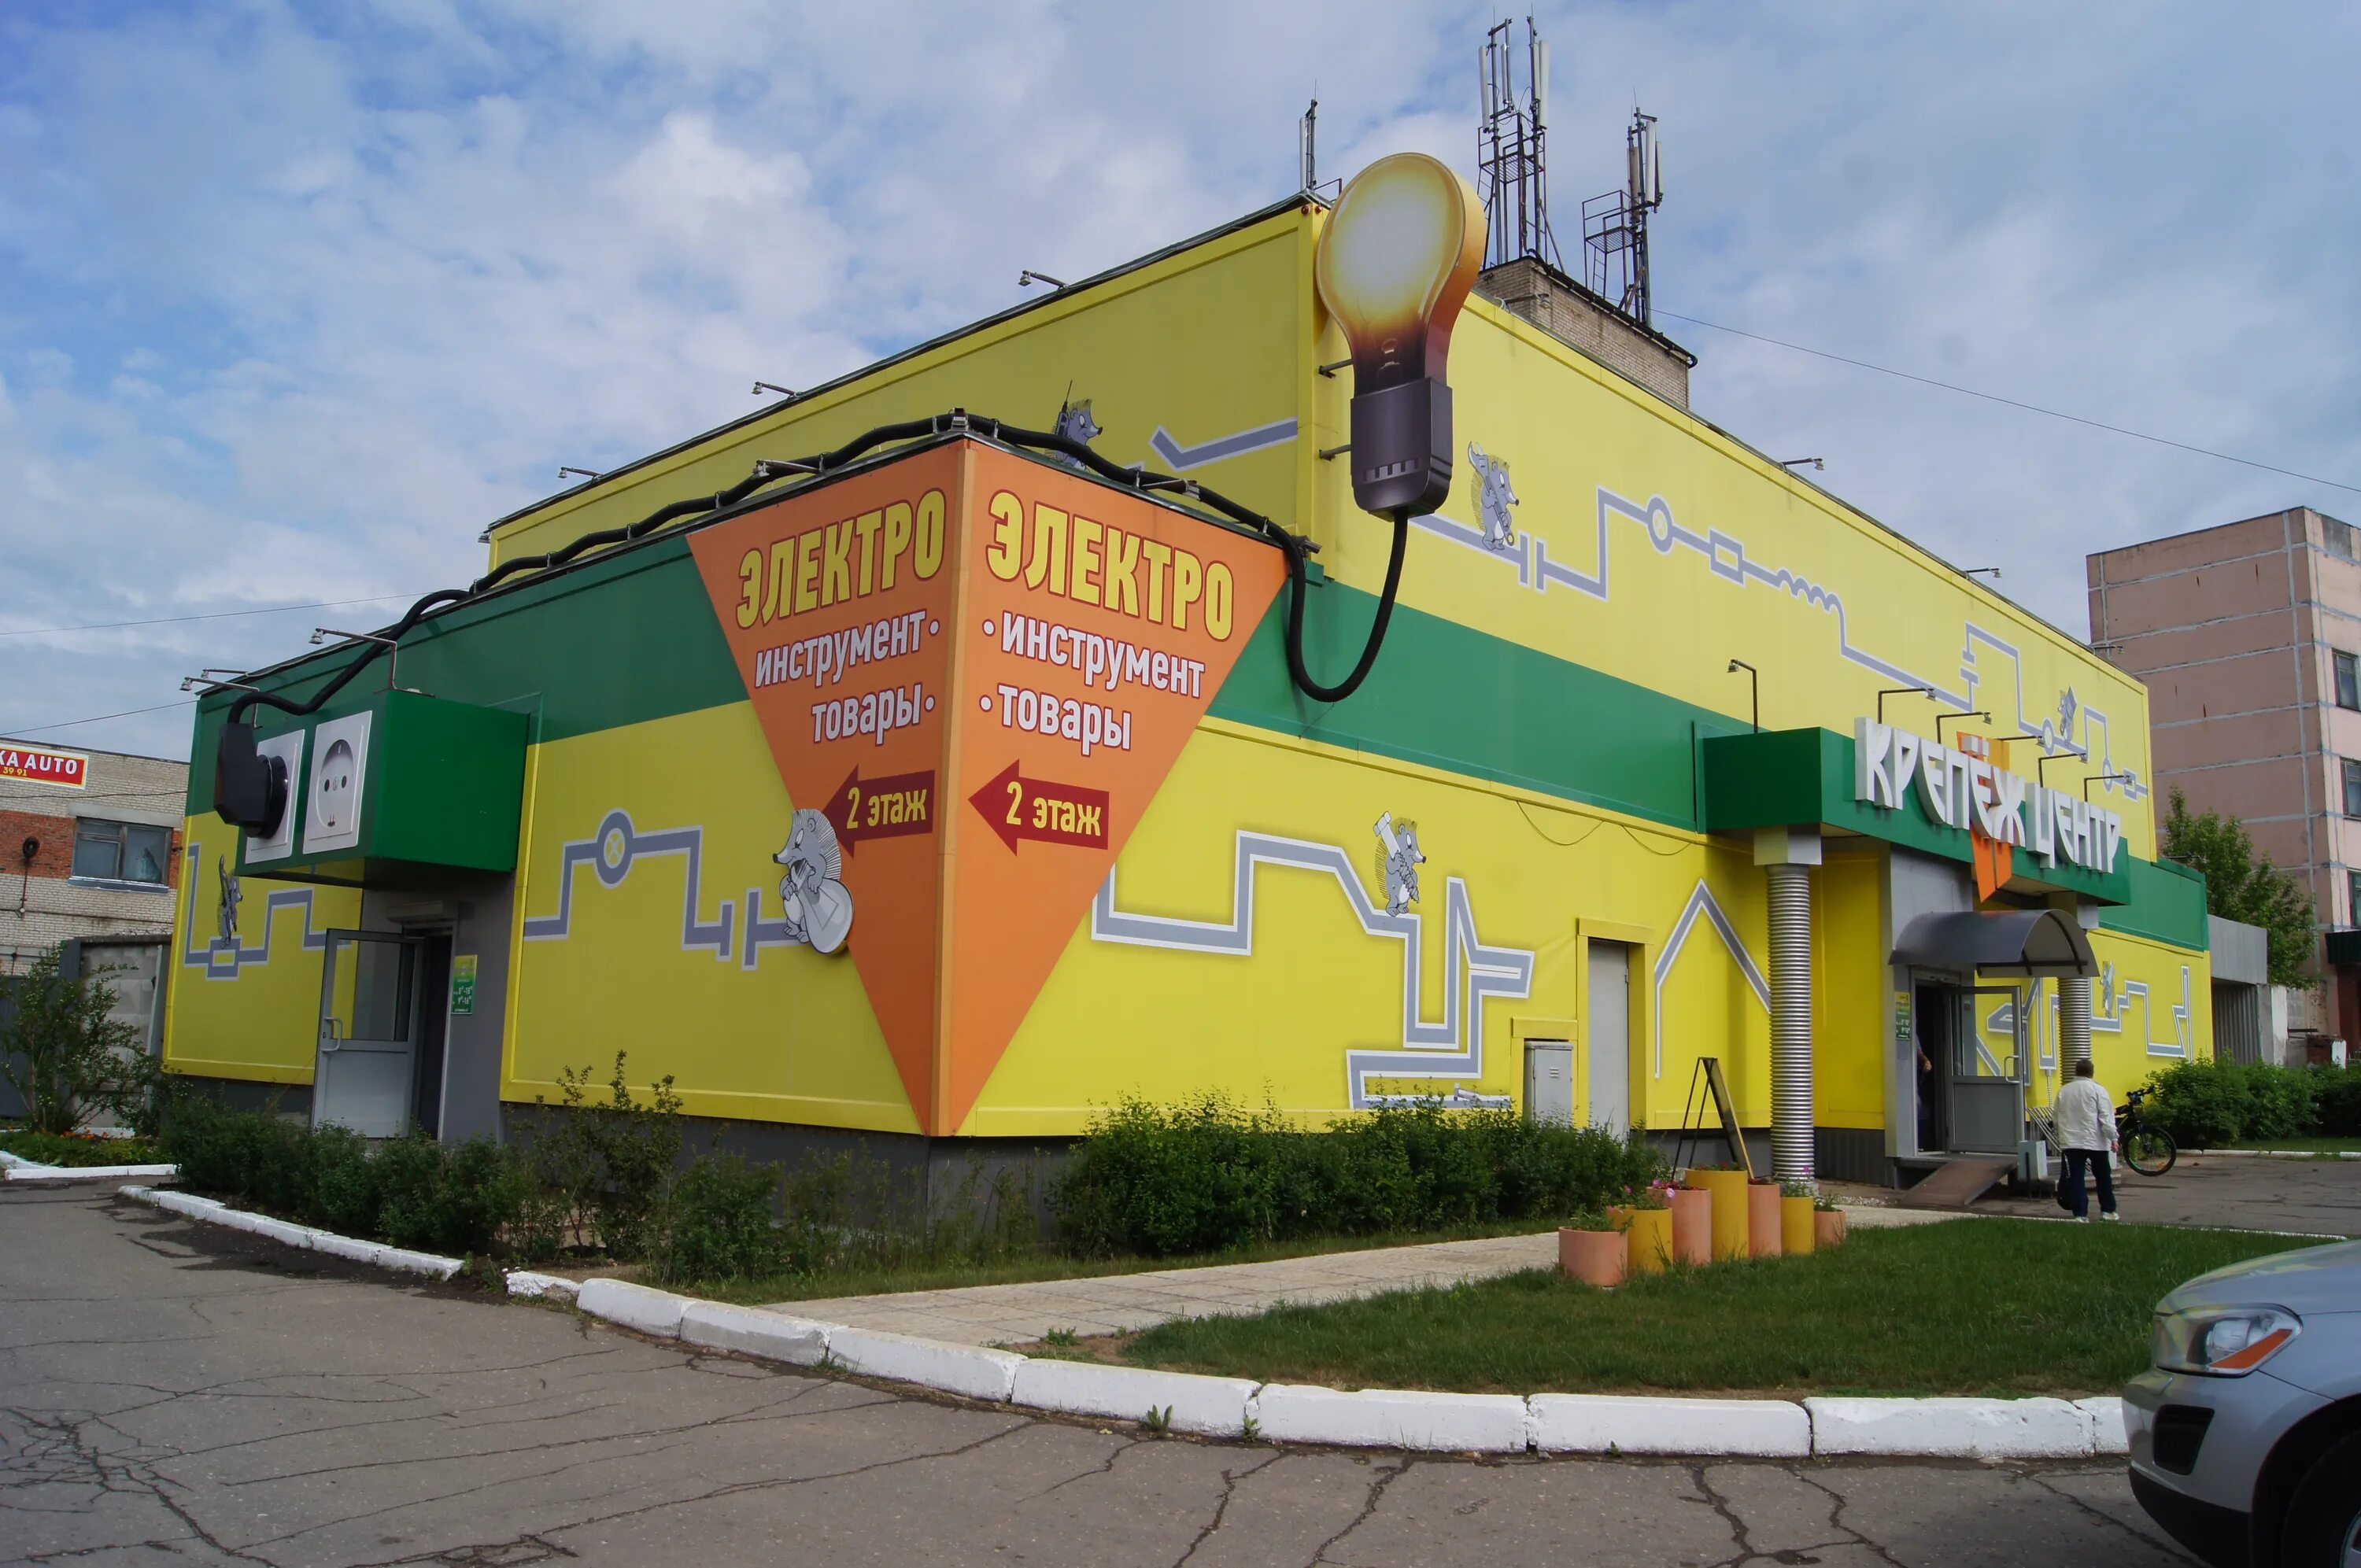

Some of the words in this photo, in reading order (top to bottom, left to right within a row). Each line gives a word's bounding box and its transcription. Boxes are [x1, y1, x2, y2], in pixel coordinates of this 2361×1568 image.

[736, 488, 946, 629] ЭЛЕКТРО
[985, 489, 1234, 641] ЭЛЕКТРО
[755, 609, 926, 689] инструмент
[1000, 610, 1205, 699] инструмент
[811, 682, 922, 746] товары
[997, 683, 1132, 757] товары
[17, 768, 28, 777] 91
[24, 754, 78, 775] AUTO
[1854, 717, 2026, 848] КРЕПЁЖ
[2025, 782, 2122, 874] ЦЕНТР
[846, 786, 860, 829] 2
[867, 788, 927, 827] этаж
[1006, 781, 1023, 826] 2
[1033, 796, 1102, 836] этаж
